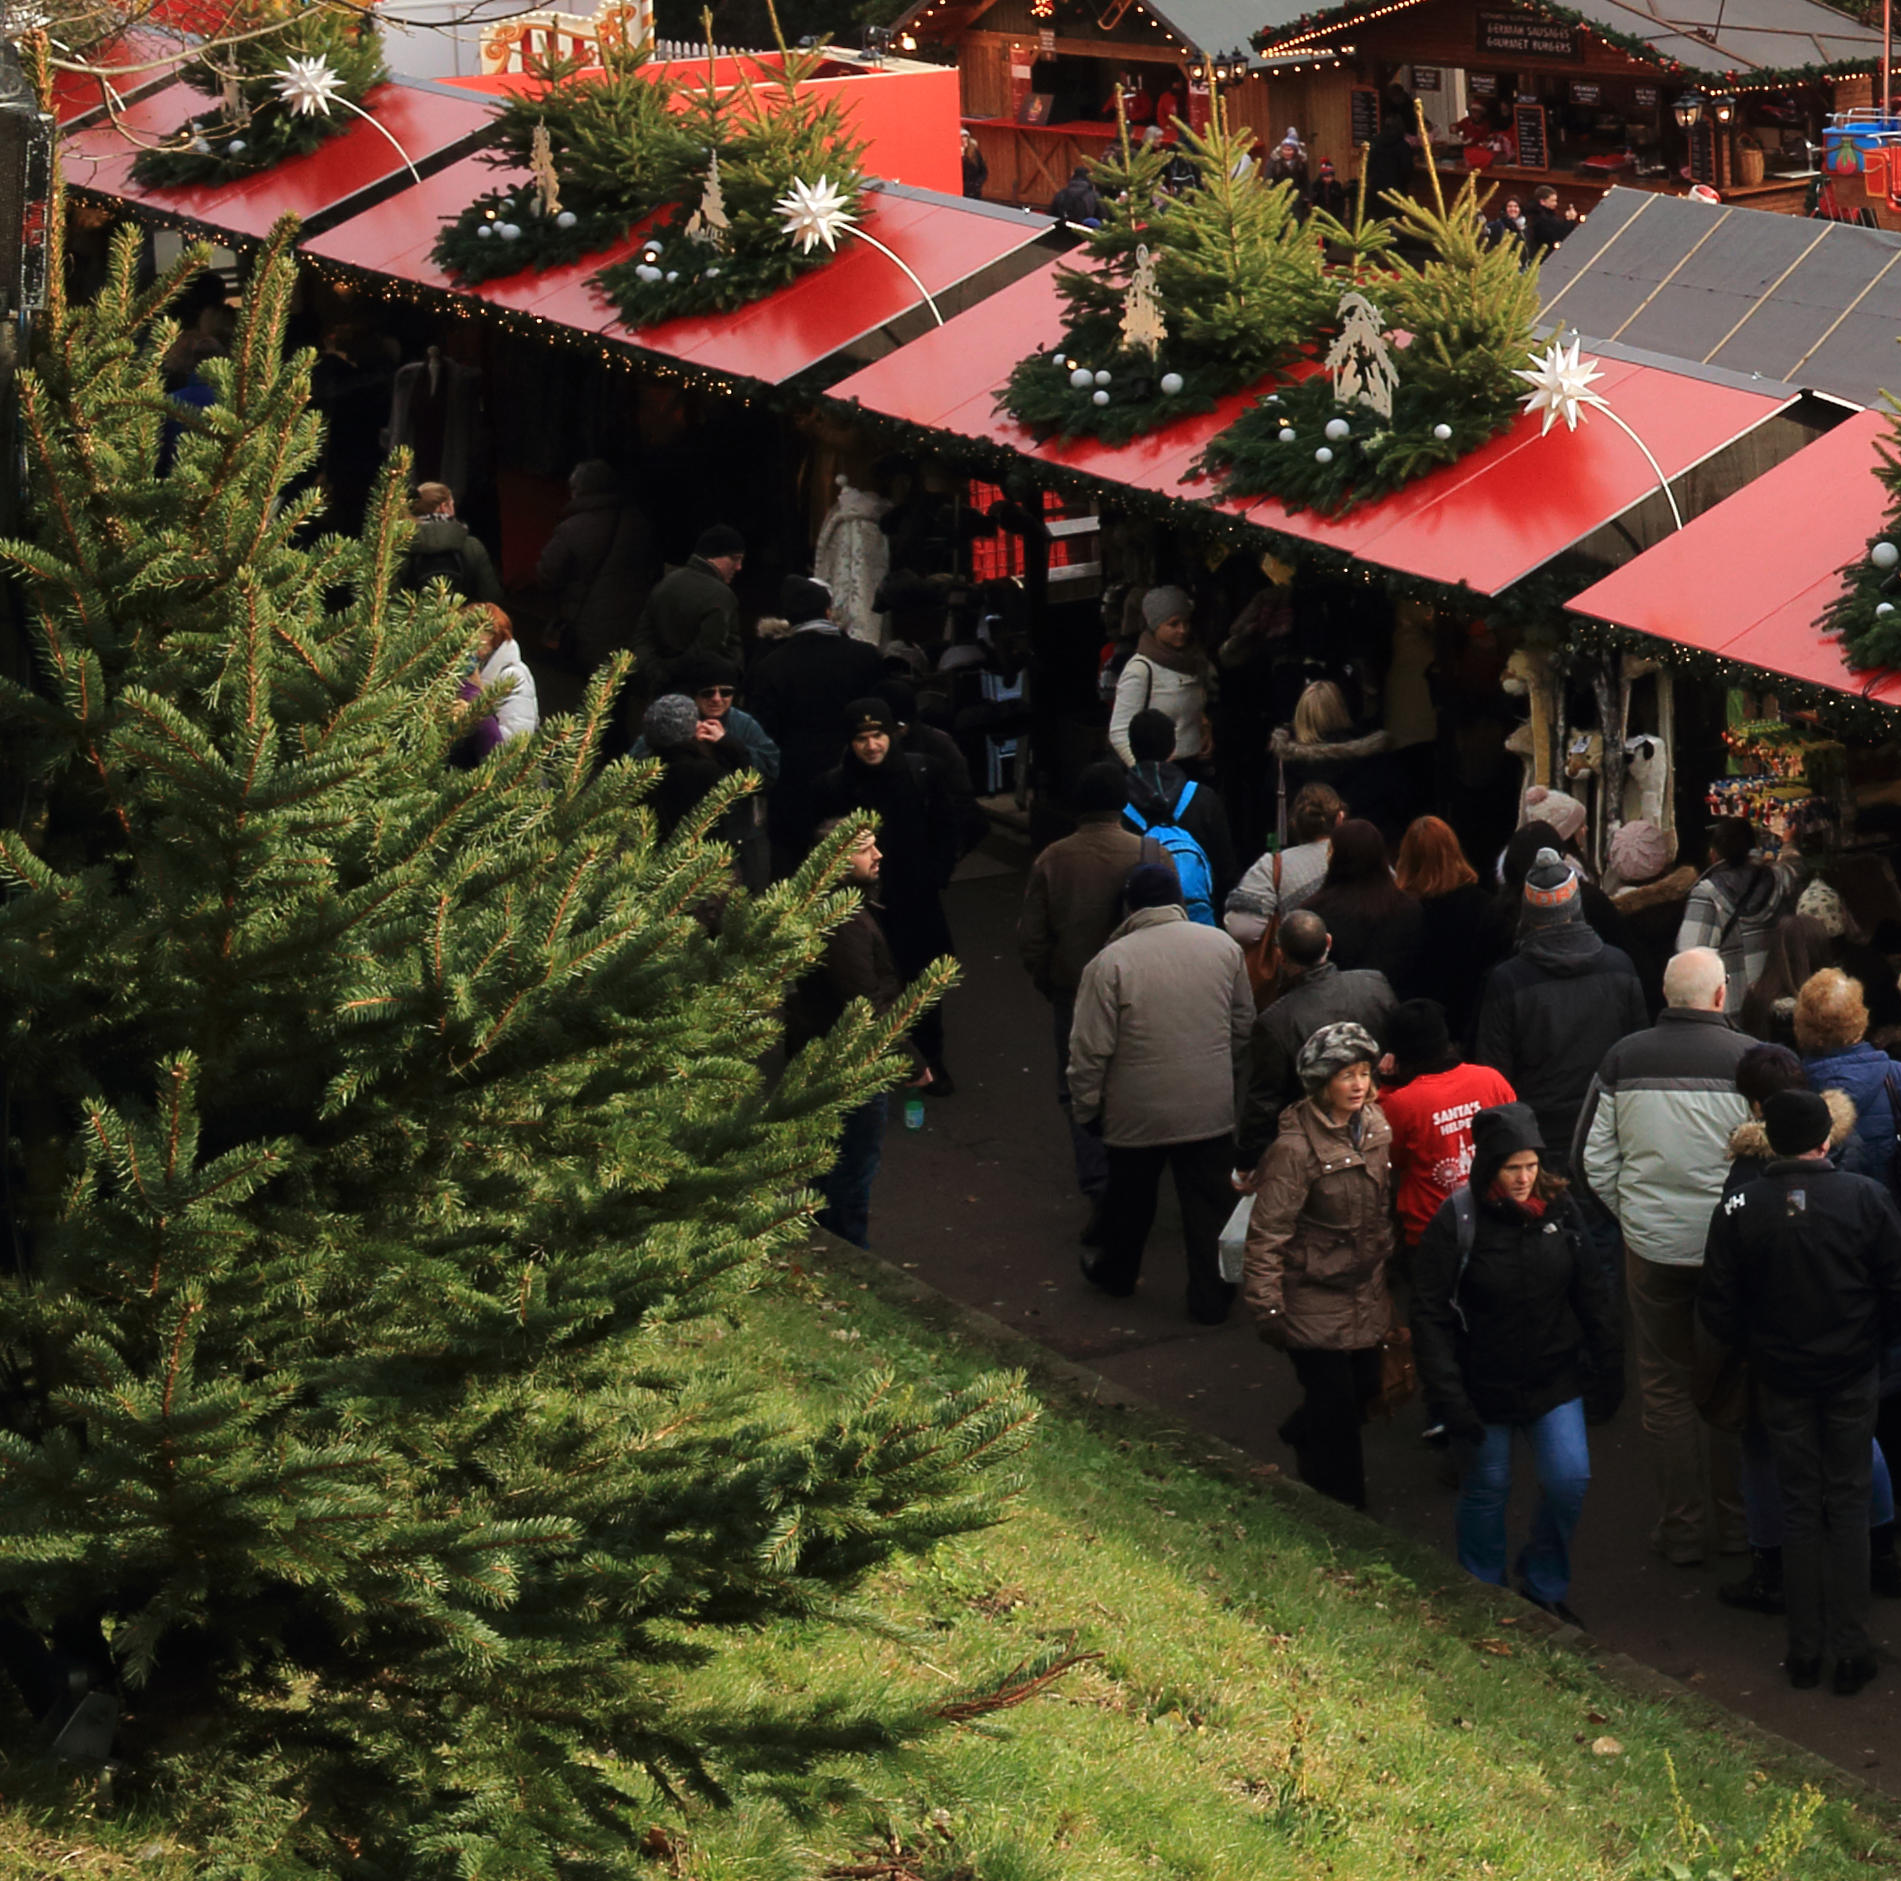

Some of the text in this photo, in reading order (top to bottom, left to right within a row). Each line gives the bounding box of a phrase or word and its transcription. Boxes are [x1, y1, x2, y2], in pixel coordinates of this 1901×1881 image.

[1487, 22, 1570, 39] GERMAN SAUSAGES
[1486, 37, 1571, 54] GOURMET BURGERS
[1432, 1100, 1482, 1125] SANTA'S
[1440, 1117, 1473, 1136] HELPE
